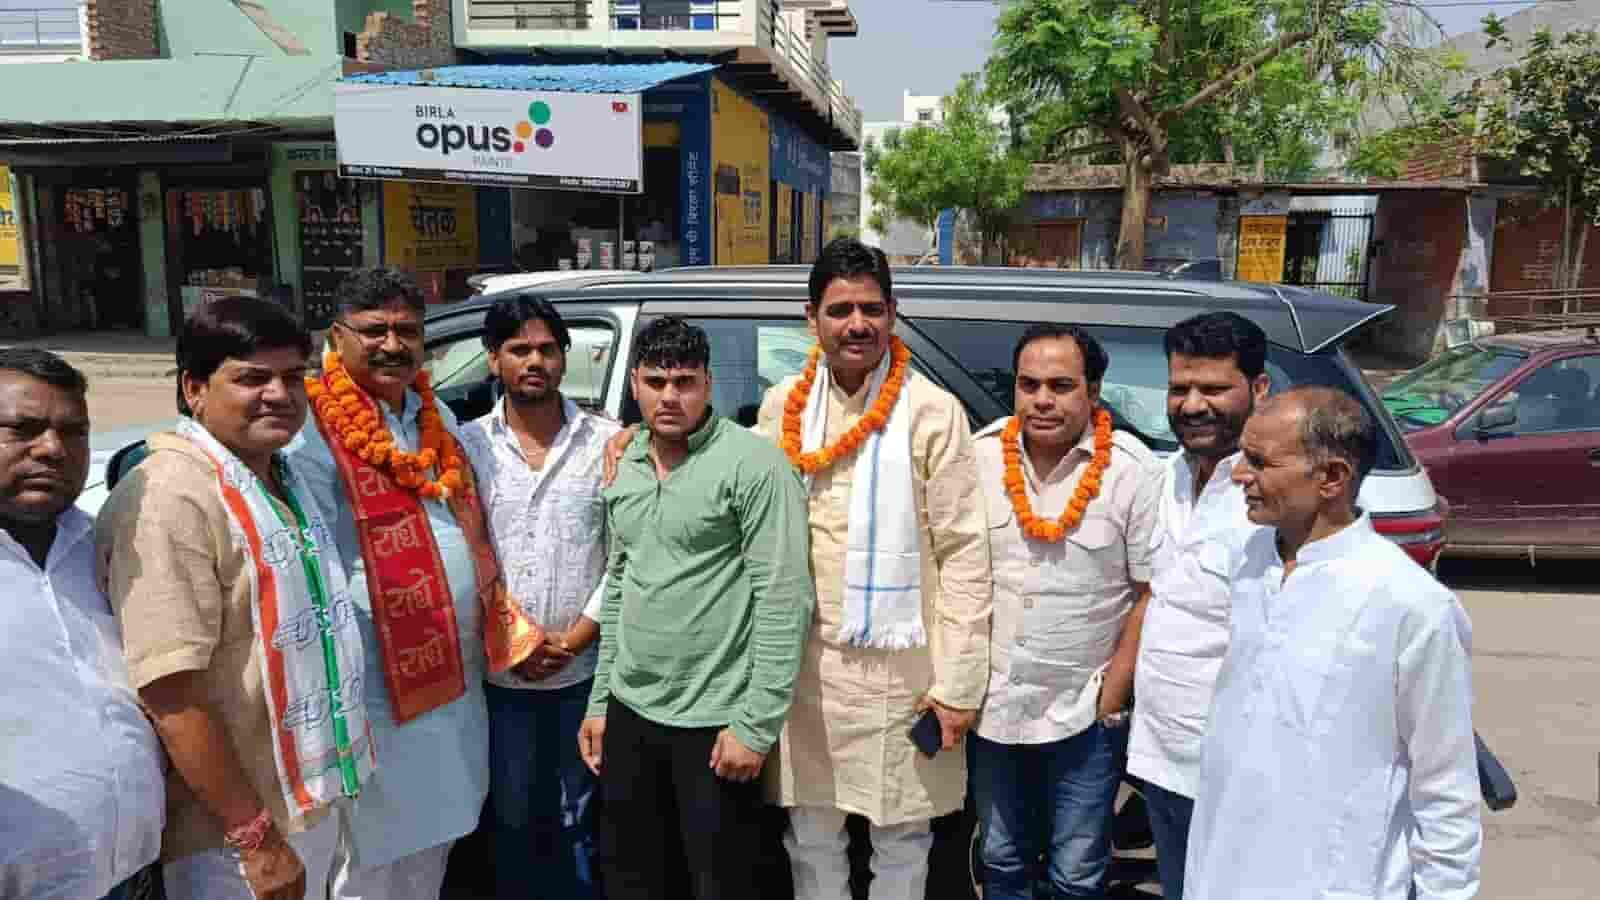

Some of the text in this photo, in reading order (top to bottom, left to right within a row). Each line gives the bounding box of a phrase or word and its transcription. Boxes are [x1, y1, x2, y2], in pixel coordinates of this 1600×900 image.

[416, 104, 455, 119] BIRLA
[416, 123, 512, 155] opus
[408, 195, 457, 238] चेतक
[370, 511, 422, 557] राधे
[384, 567, 436, 619] राधे
[399, 628, 445, 678] राधे
